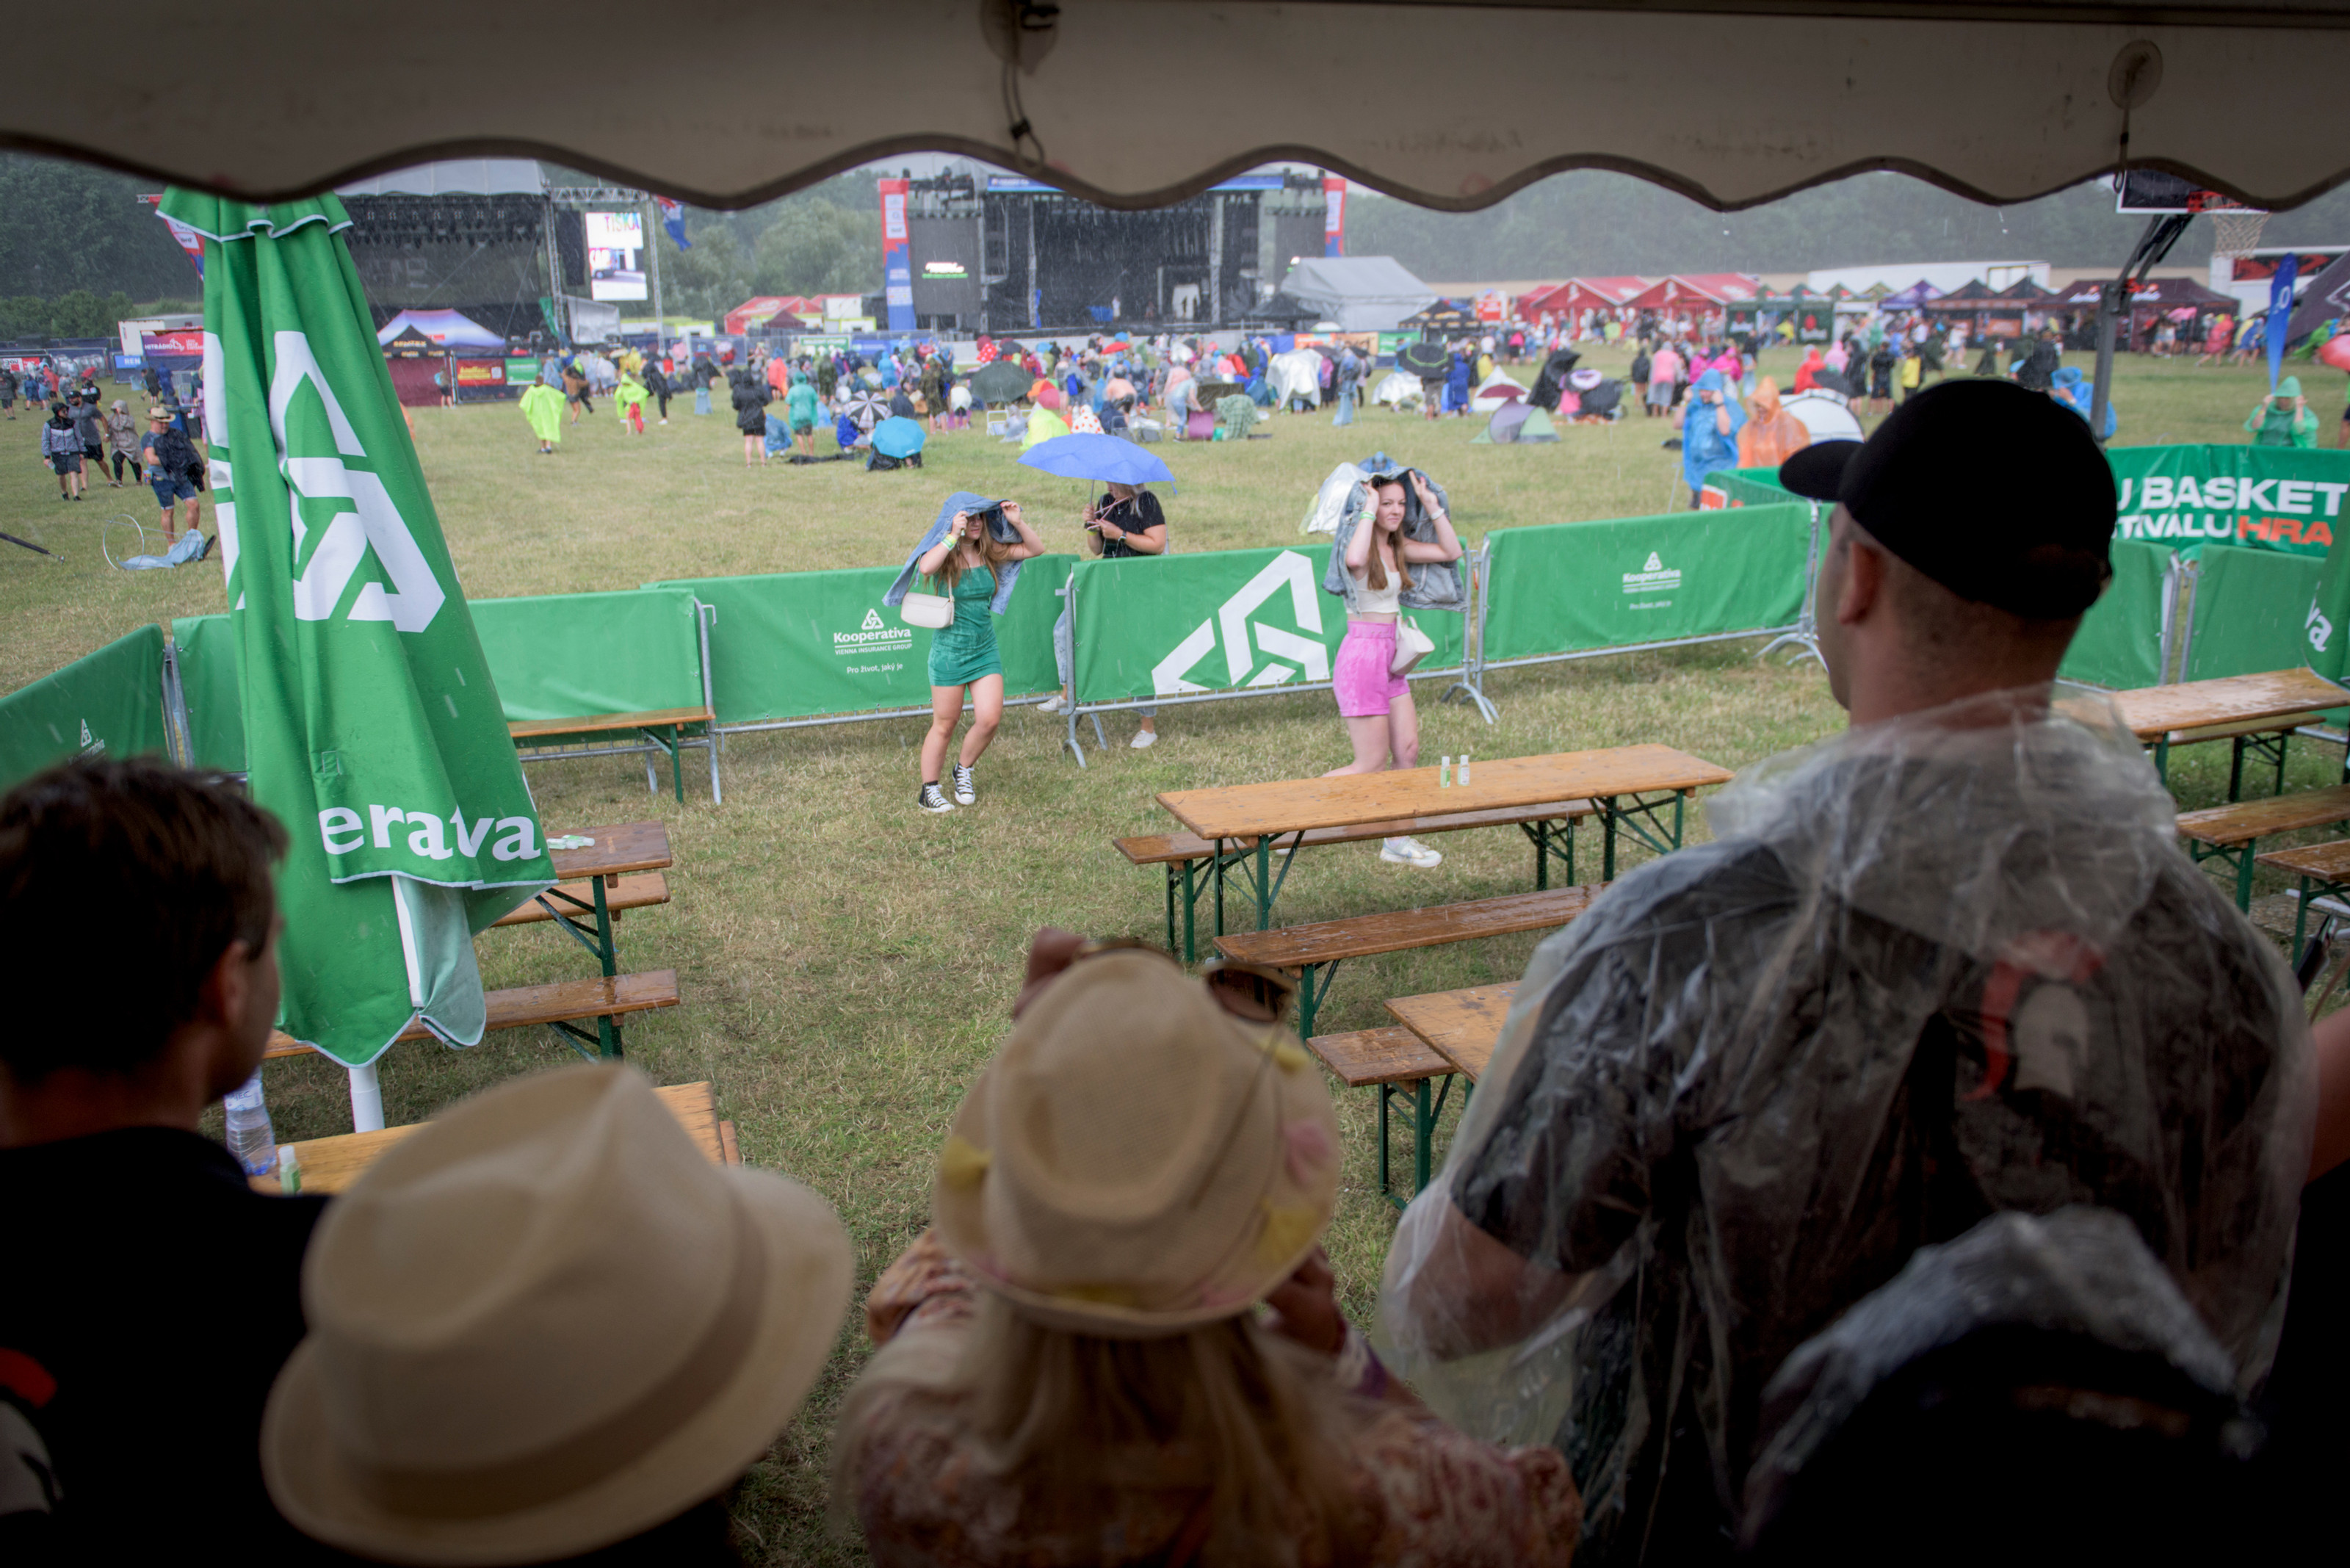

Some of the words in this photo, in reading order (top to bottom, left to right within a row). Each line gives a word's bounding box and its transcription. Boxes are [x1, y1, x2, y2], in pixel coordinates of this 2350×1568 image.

[2141, 476, 2349, 516] BASKET
[2111, 513, 2232, 539] TIVALU
[834, 626, 911, 643] Kooperativa
[858, 645, 892, 653] INSURANCE
